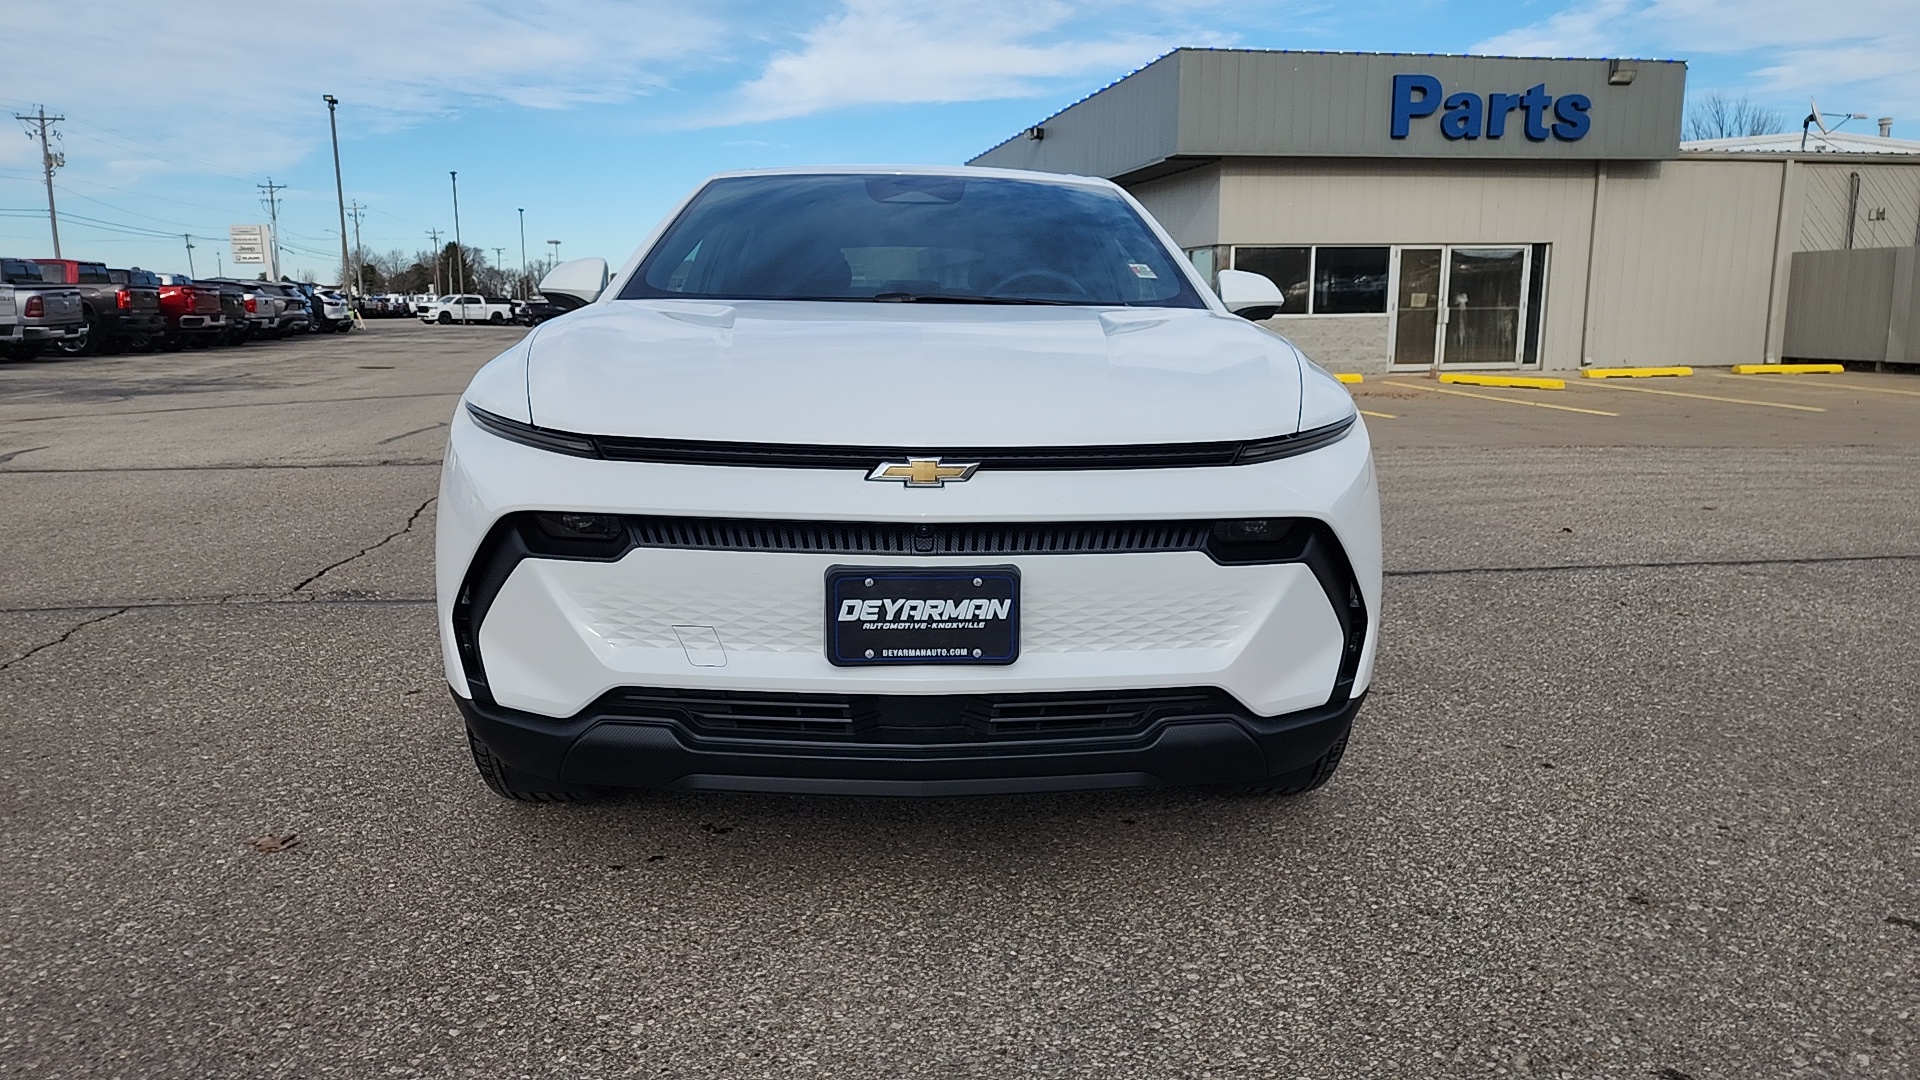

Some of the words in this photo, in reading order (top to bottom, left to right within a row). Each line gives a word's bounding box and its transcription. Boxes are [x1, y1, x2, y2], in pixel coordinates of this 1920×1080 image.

[1390, 74, 1592, 141] Parts
[837, 599, 1012, 621] DEYARMAN
[862, 621, 986, 630] AUTOMOTIVE-KNOXVILLE
[882, 648, 968, 657] DEYARMANAUTO.COM
